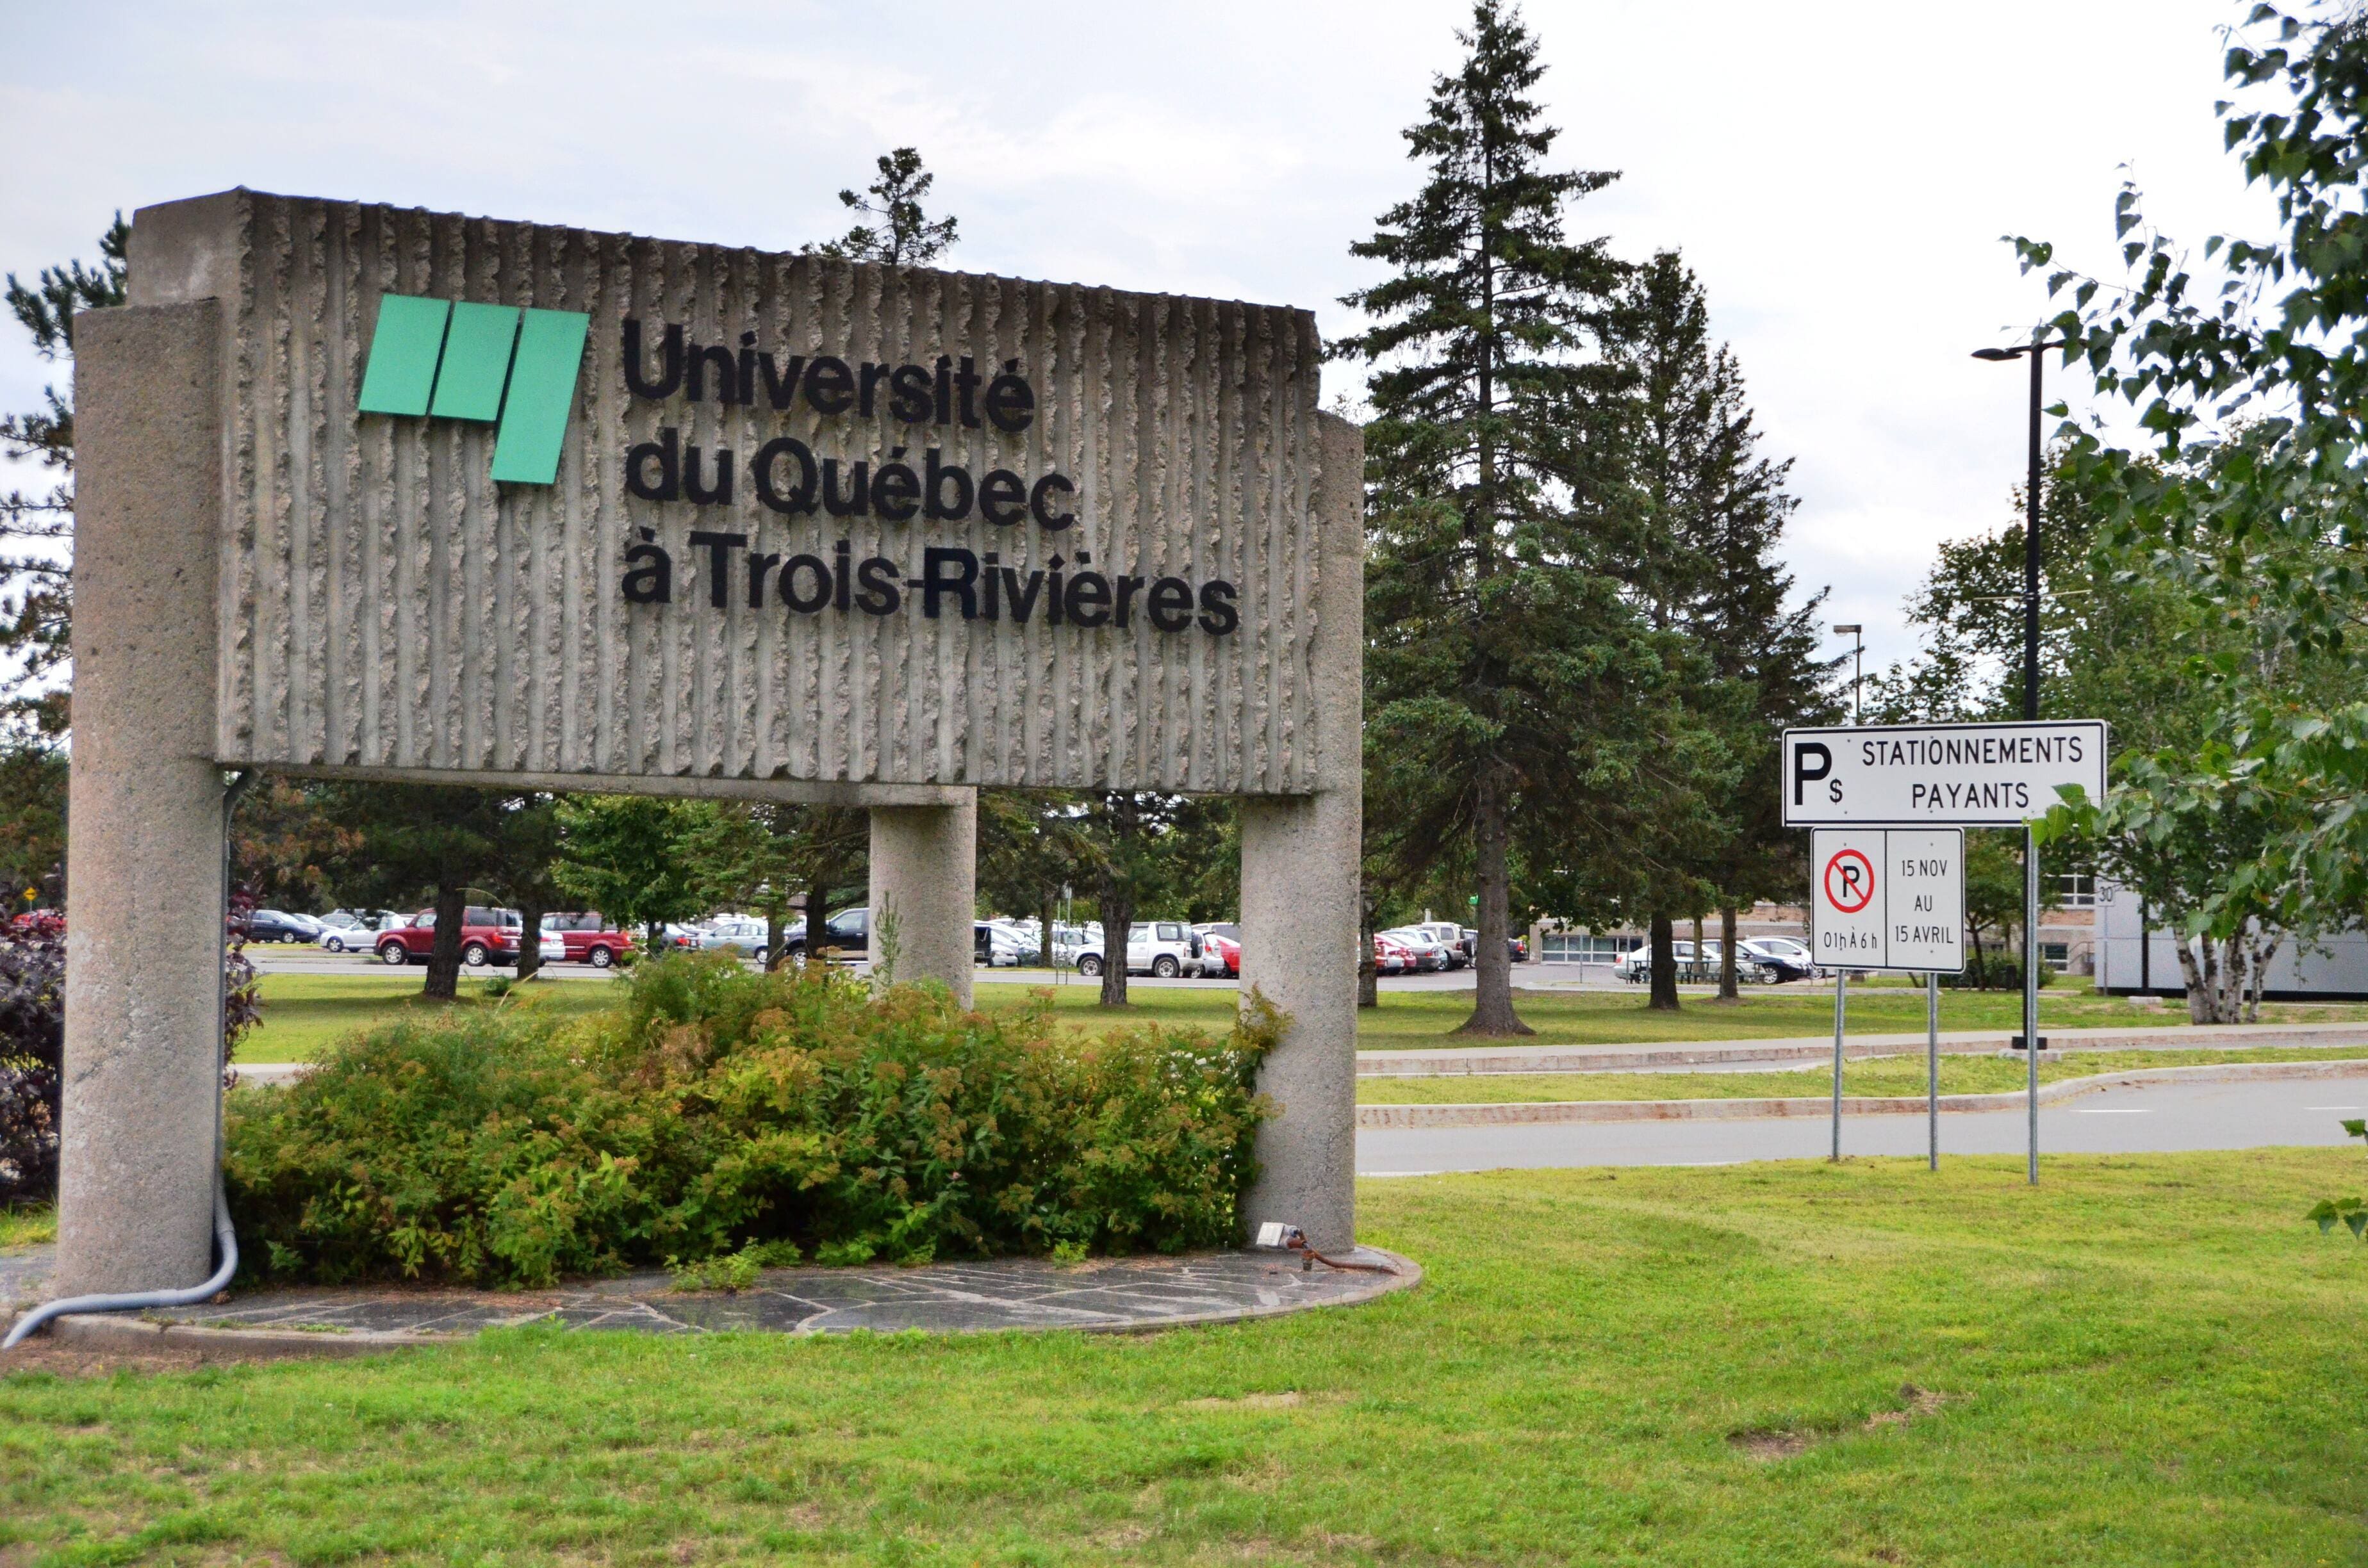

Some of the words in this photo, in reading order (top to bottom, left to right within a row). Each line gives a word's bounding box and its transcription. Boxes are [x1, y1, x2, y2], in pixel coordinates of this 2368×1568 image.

[623, 320, 1035, 433] Université
[625, 427, 733, 506] du
[753, 437, 1075, 530] Québec
[621, 527, 672, 604] à
[689, 530, 1238, 636] Trois-Rivières
[1862, 736, 2083, 766] STATIONNEMENTS
[1795, 742, 1832, 806] P
[1912, 782, 2029, 809] PAYANTS
[1901, 860, 1914, 877] 15
[1919, 860, 1947, 877] NOV
[1914, 895, 1932, 912] AU
[1895, 926, 1909, 943] 15
[1913, 926, 1953, 944] AVRIL
